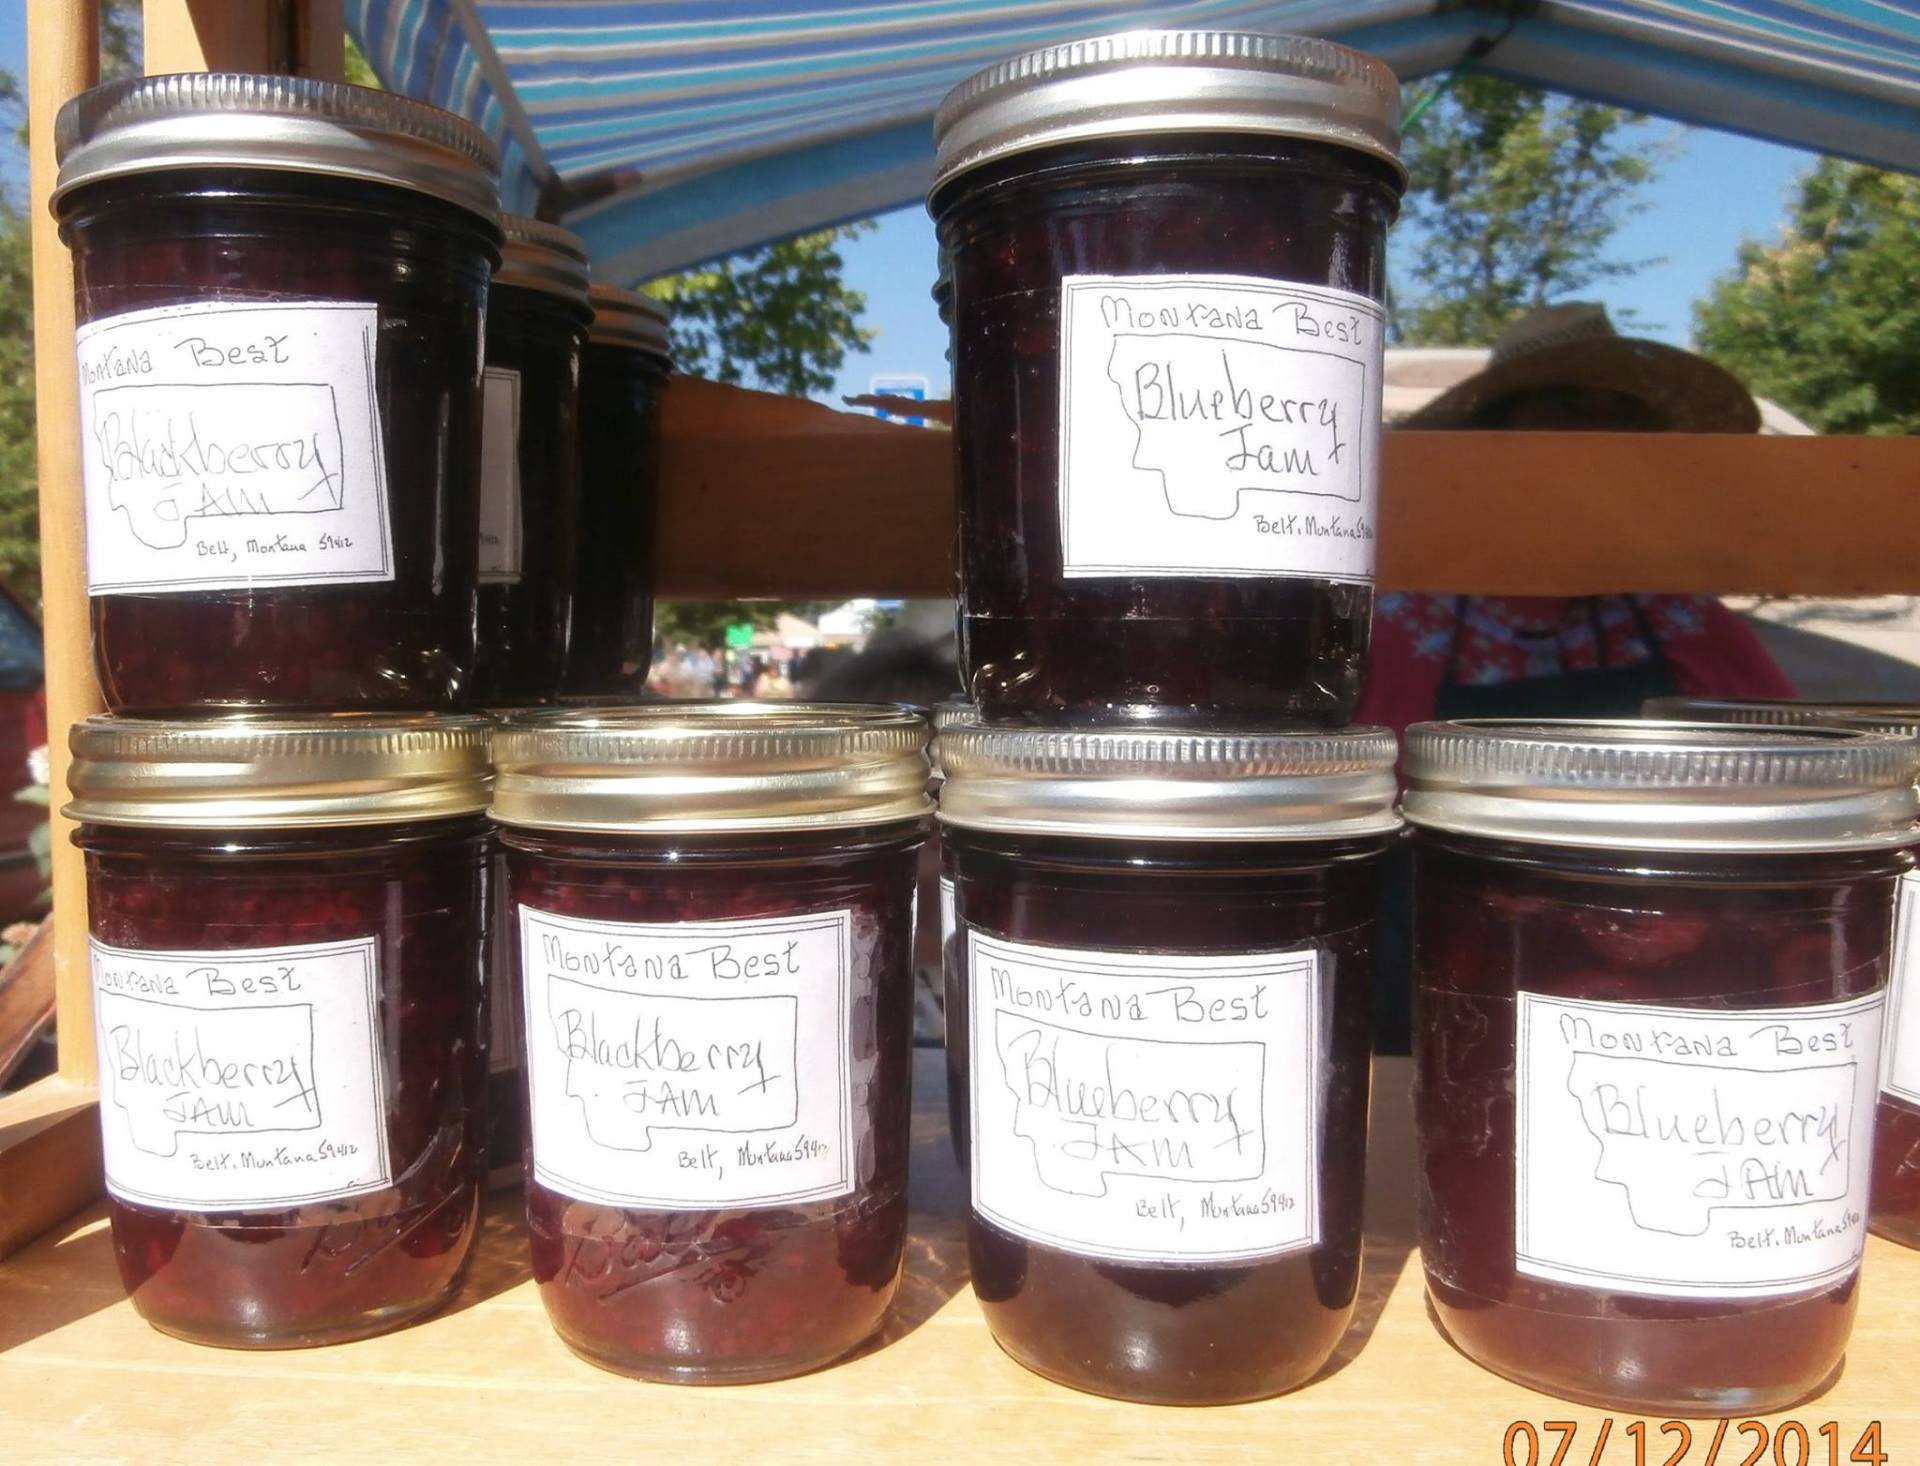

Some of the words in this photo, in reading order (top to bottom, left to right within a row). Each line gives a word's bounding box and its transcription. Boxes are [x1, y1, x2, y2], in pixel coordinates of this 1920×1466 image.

[1100, 295, 1264, 328] Montana
[1272, 302, 1362, 345] Best
[173, 335, 289, 367] Best
[1135, 349, 1346, 464] Blueberry
[101, 409, 339, 505] Blackberry
[1218, 423, 1320, 476] Jam
[246, 533, 307, 554] Montana
[186, 967, 301, 996] Best
[542, 934, 689, 980] Montana
[685, 941, 800, 979] Best
[990, 966, 1149, 1020] Montana
[1146, 984, 1268, 1022] Best
[558, 1008, 781, 1095] Blackberry
[1560, 1013, 1737, 1056] Montana
[1749, 1023, 1853, 1055] Best
[110, 1024, 315, 1112] Blackberry
[1008, 1029, 1254, 1155] Blueberry
[1592, 1085, 1845, 1175] Blueberry
